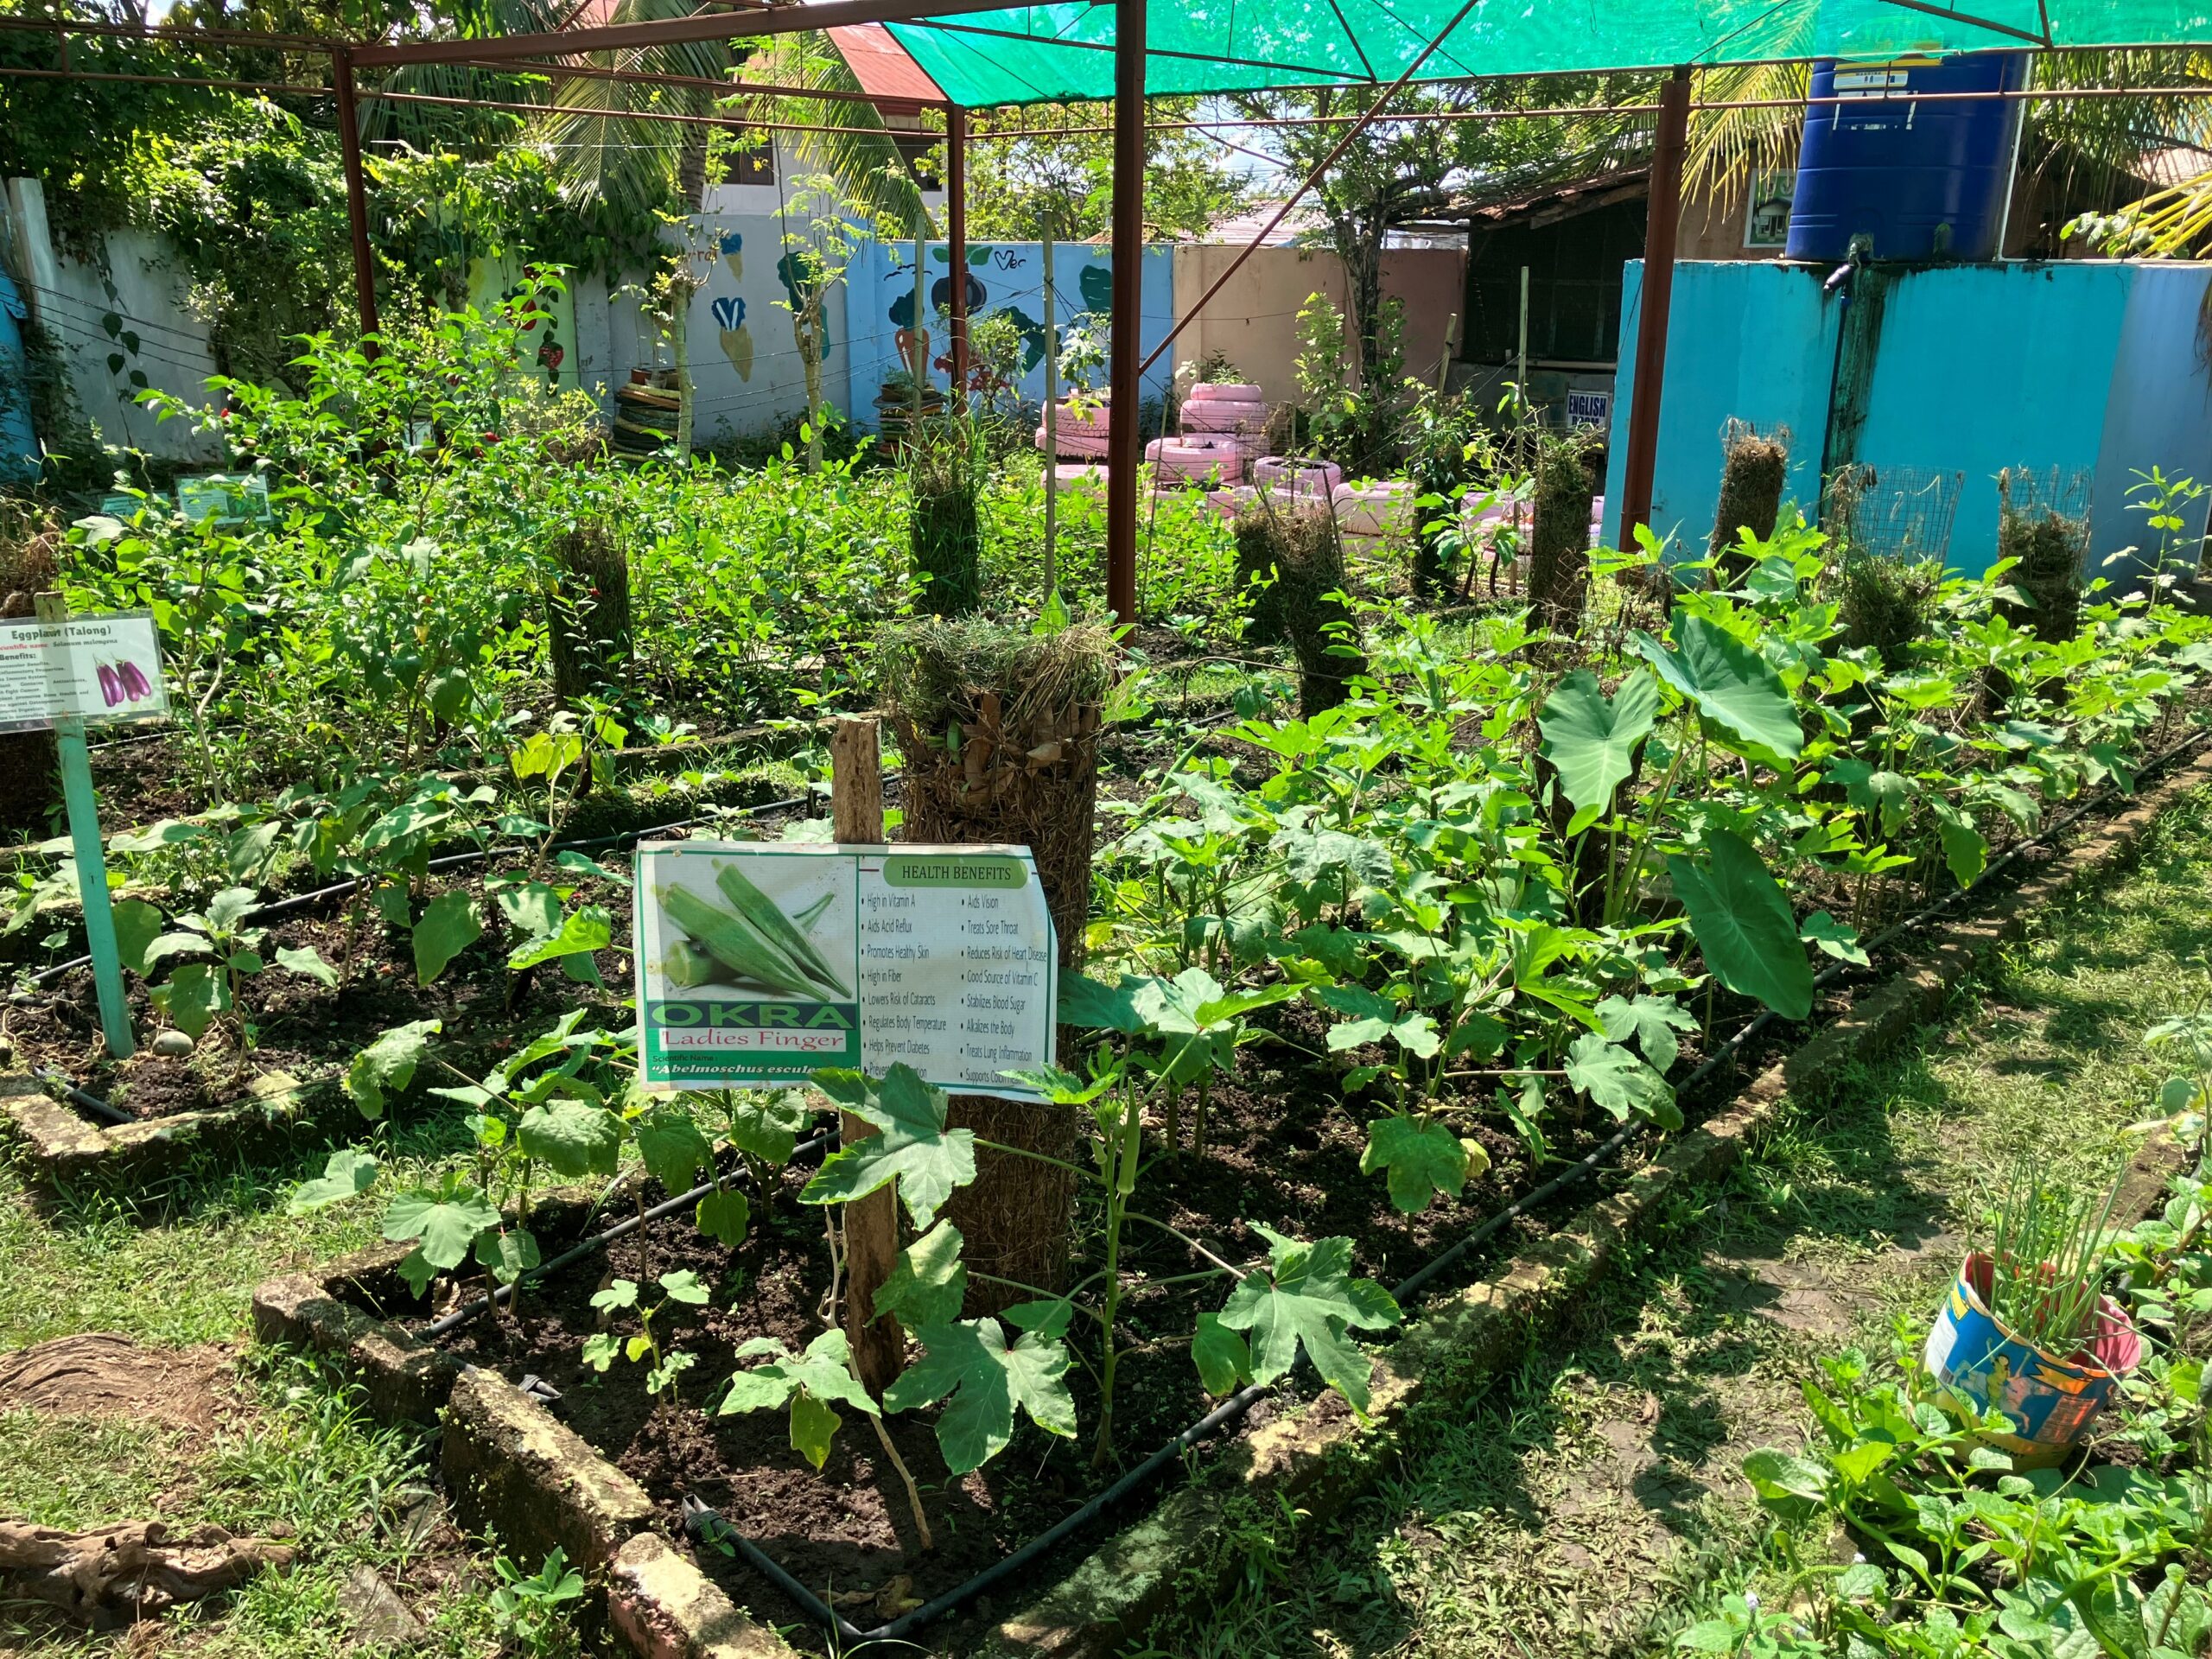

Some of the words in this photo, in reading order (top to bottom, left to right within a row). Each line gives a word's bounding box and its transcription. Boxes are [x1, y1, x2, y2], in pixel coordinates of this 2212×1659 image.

[1568, 394, 1607, 417] ENGLISH
[64, 625, 111, 637] (Talong)
[902, 865, 950, 879] HEALTH
[953, 866, 1011, 880] BENEFITS
[867, 893, 880, 912] High
[882, 893, 887, 907] in
[888, 893, 910, 907] Vitamin
[911, 893, 916, 907] A
[968, 894, 981, 908] Aids
[982, 894, 999, 908] Vision
[868, 918, 880, 932] Aids
[881, 918, 894, 932] Acid
[895, 918, 912, 933] Reflux
[968, 920, 984, 934] Treats
[986, 920, 1000, 934] Sore
[1001, 920, 1019, 934] Throat
[867, 944, 894, 958] Promotes
[895, 944, 916, 964] Healthy
[918, 943, 930, 959] Skin
[967, 945, 990, 960] Reduces
[992, 946, 1002, 960] Risk
[1004, 945, 1011, 960] of
[1012, 946, 1027, 961] Heart
[1028, 946, 1047, 962] Disease
[867, 969, 880, 986] High
[882, 969, 887, 982] in
[888, 969, 902, 982] Fiber
[967, 969, 983, 983] Good
[984, 969, 1003, 984] Source
[1005, 970, 1011, 984] of
[1013, 970, 1033, 985] Vitamin
[1033, 972, 1039, 986] C
[868, 992, 888, 1006] Lowers
[890, 991, 900, 1005] Risk
[902, 991, 909, 1005] of
[910, 992, 936, 1006] Cataracts
[967, 994, 991, 1009] Stabilizes
[993, 995, 1008, 1010] Blood
[1010, 996, 1026, 1014] Sugar
[652, 1003, 854, 1029] OKRA
[868, 1014, 895, 1032] Regulates
[897, 1015, 912, 1033] Body
[913, 1015, 947, 1033] Temperature
[966, 1018, 989, 1033] Alkalizes
[990, 1020, 1000, 1034] the
[1001, 1020, 1015, 1038] Body
[662, 1028, 749, 1046] Ladies
[757, 1030, 844, 1051] Finger
[868, 1039, 883, 1056] Helps
[885, 1039, 906, 1053] Prevent
[907, 1039, 931, 1054] Diabetes
[652, 1054, 689, 1063] Scientific
[966, 1044, 982, 1058] Treats
[983, 1045, 997, 1063] Lung
[999, 1046, 1033, 1062] Inflammation
[965, 1067, 989, 1085] Supports
